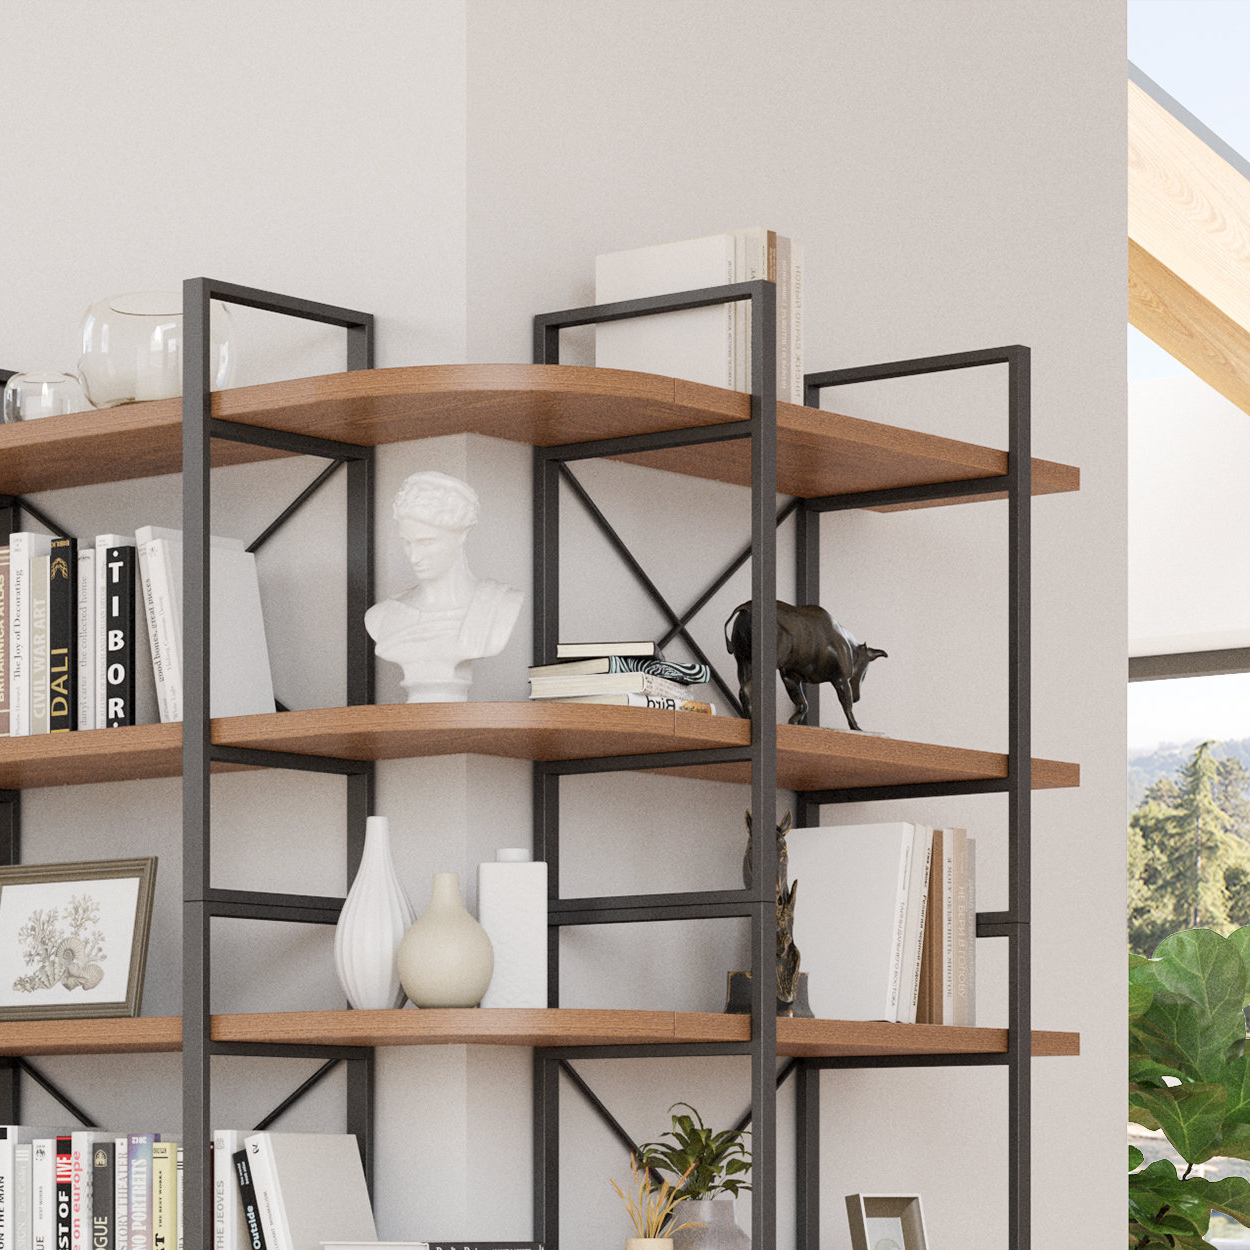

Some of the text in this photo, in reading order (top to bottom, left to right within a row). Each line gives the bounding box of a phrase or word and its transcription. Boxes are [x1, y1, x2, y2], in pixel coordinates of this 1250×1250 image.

[33, 599, 47, 719] CIVIL WAR ART
[51, 648, 69, 718] DALI
[73, 1151, 83, 1213] europe
[216, 1180, 225, 1224] JEOVES
[58, 1191, 69, 1219] OF
[73, 1218, 83, 1240] on
[216, 1227, 225, 1249] THE
